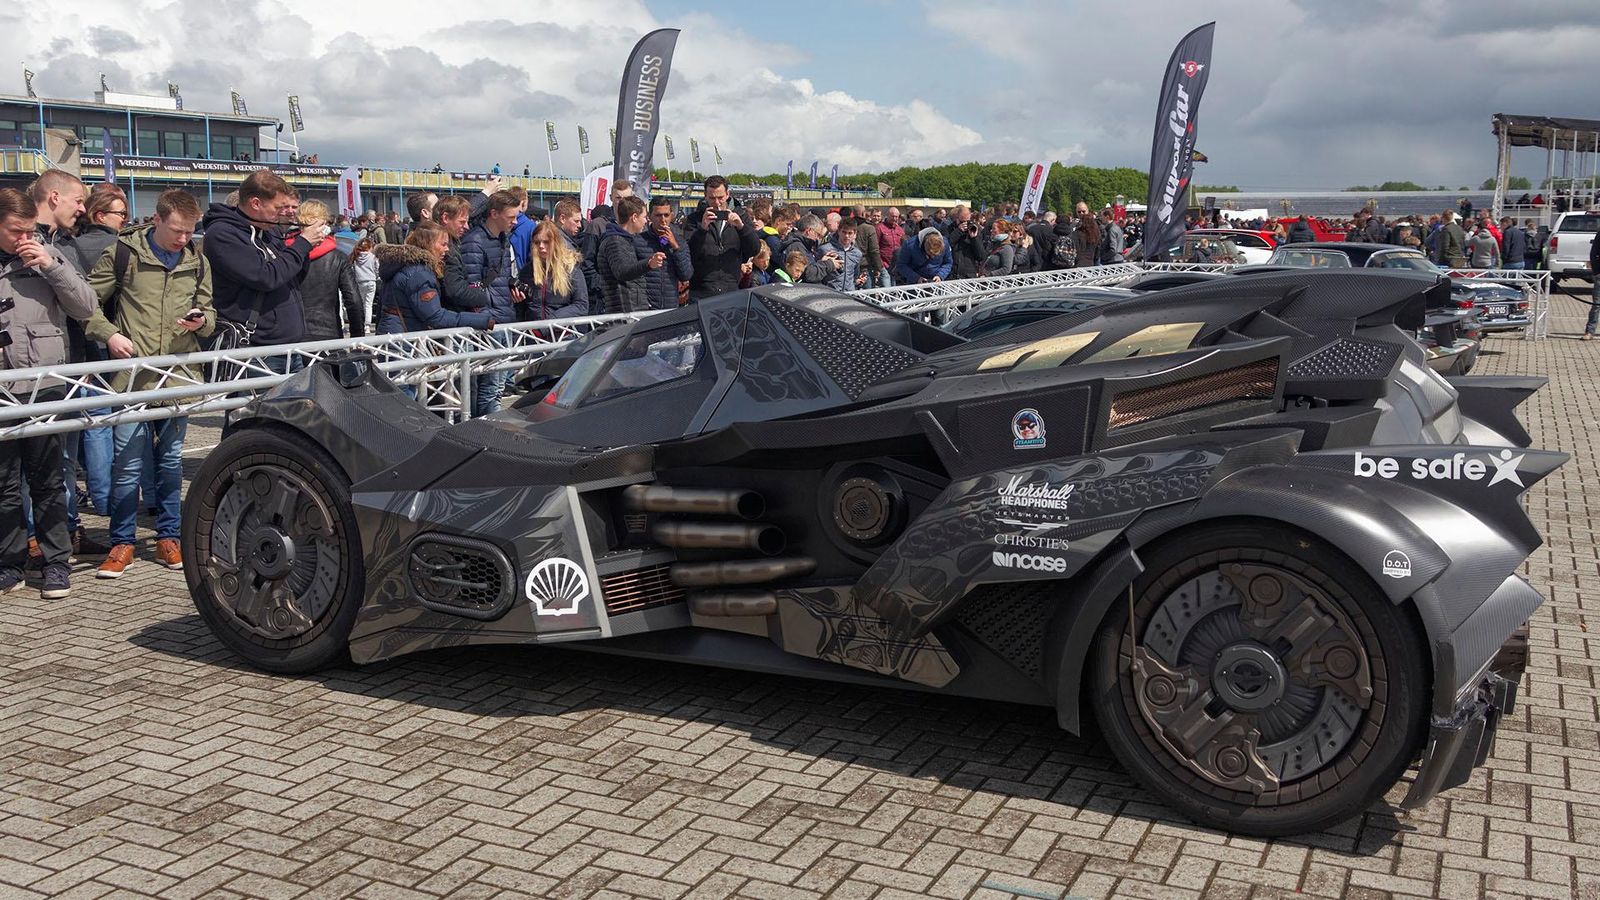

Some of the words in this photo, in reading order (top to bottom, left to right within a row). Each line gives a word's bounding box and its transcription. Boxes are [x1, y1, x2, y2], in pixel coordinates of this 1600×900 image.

[633, 54, 663, 134] BUSINESS
[119, 159, 161, 168] VREDESTEIN
[192, 162, 230, 171] VREDESTEIN
[296, 167, 329, 175] VREDESTEIN
[628, 150, 646, 190] ARS
[1354, 452, 1399, 478] be
[1411, 453, 1487, 480] safe
[998, 475, 1075, 500] Marshall
[1001, 496, 1068, 510] HEADPHONES
[995, 511, 1070, 521] JETSMARTER
[994, 533, 1069, 550] CHRISTIE'S
[1006, 552, 1067, 573] incase
